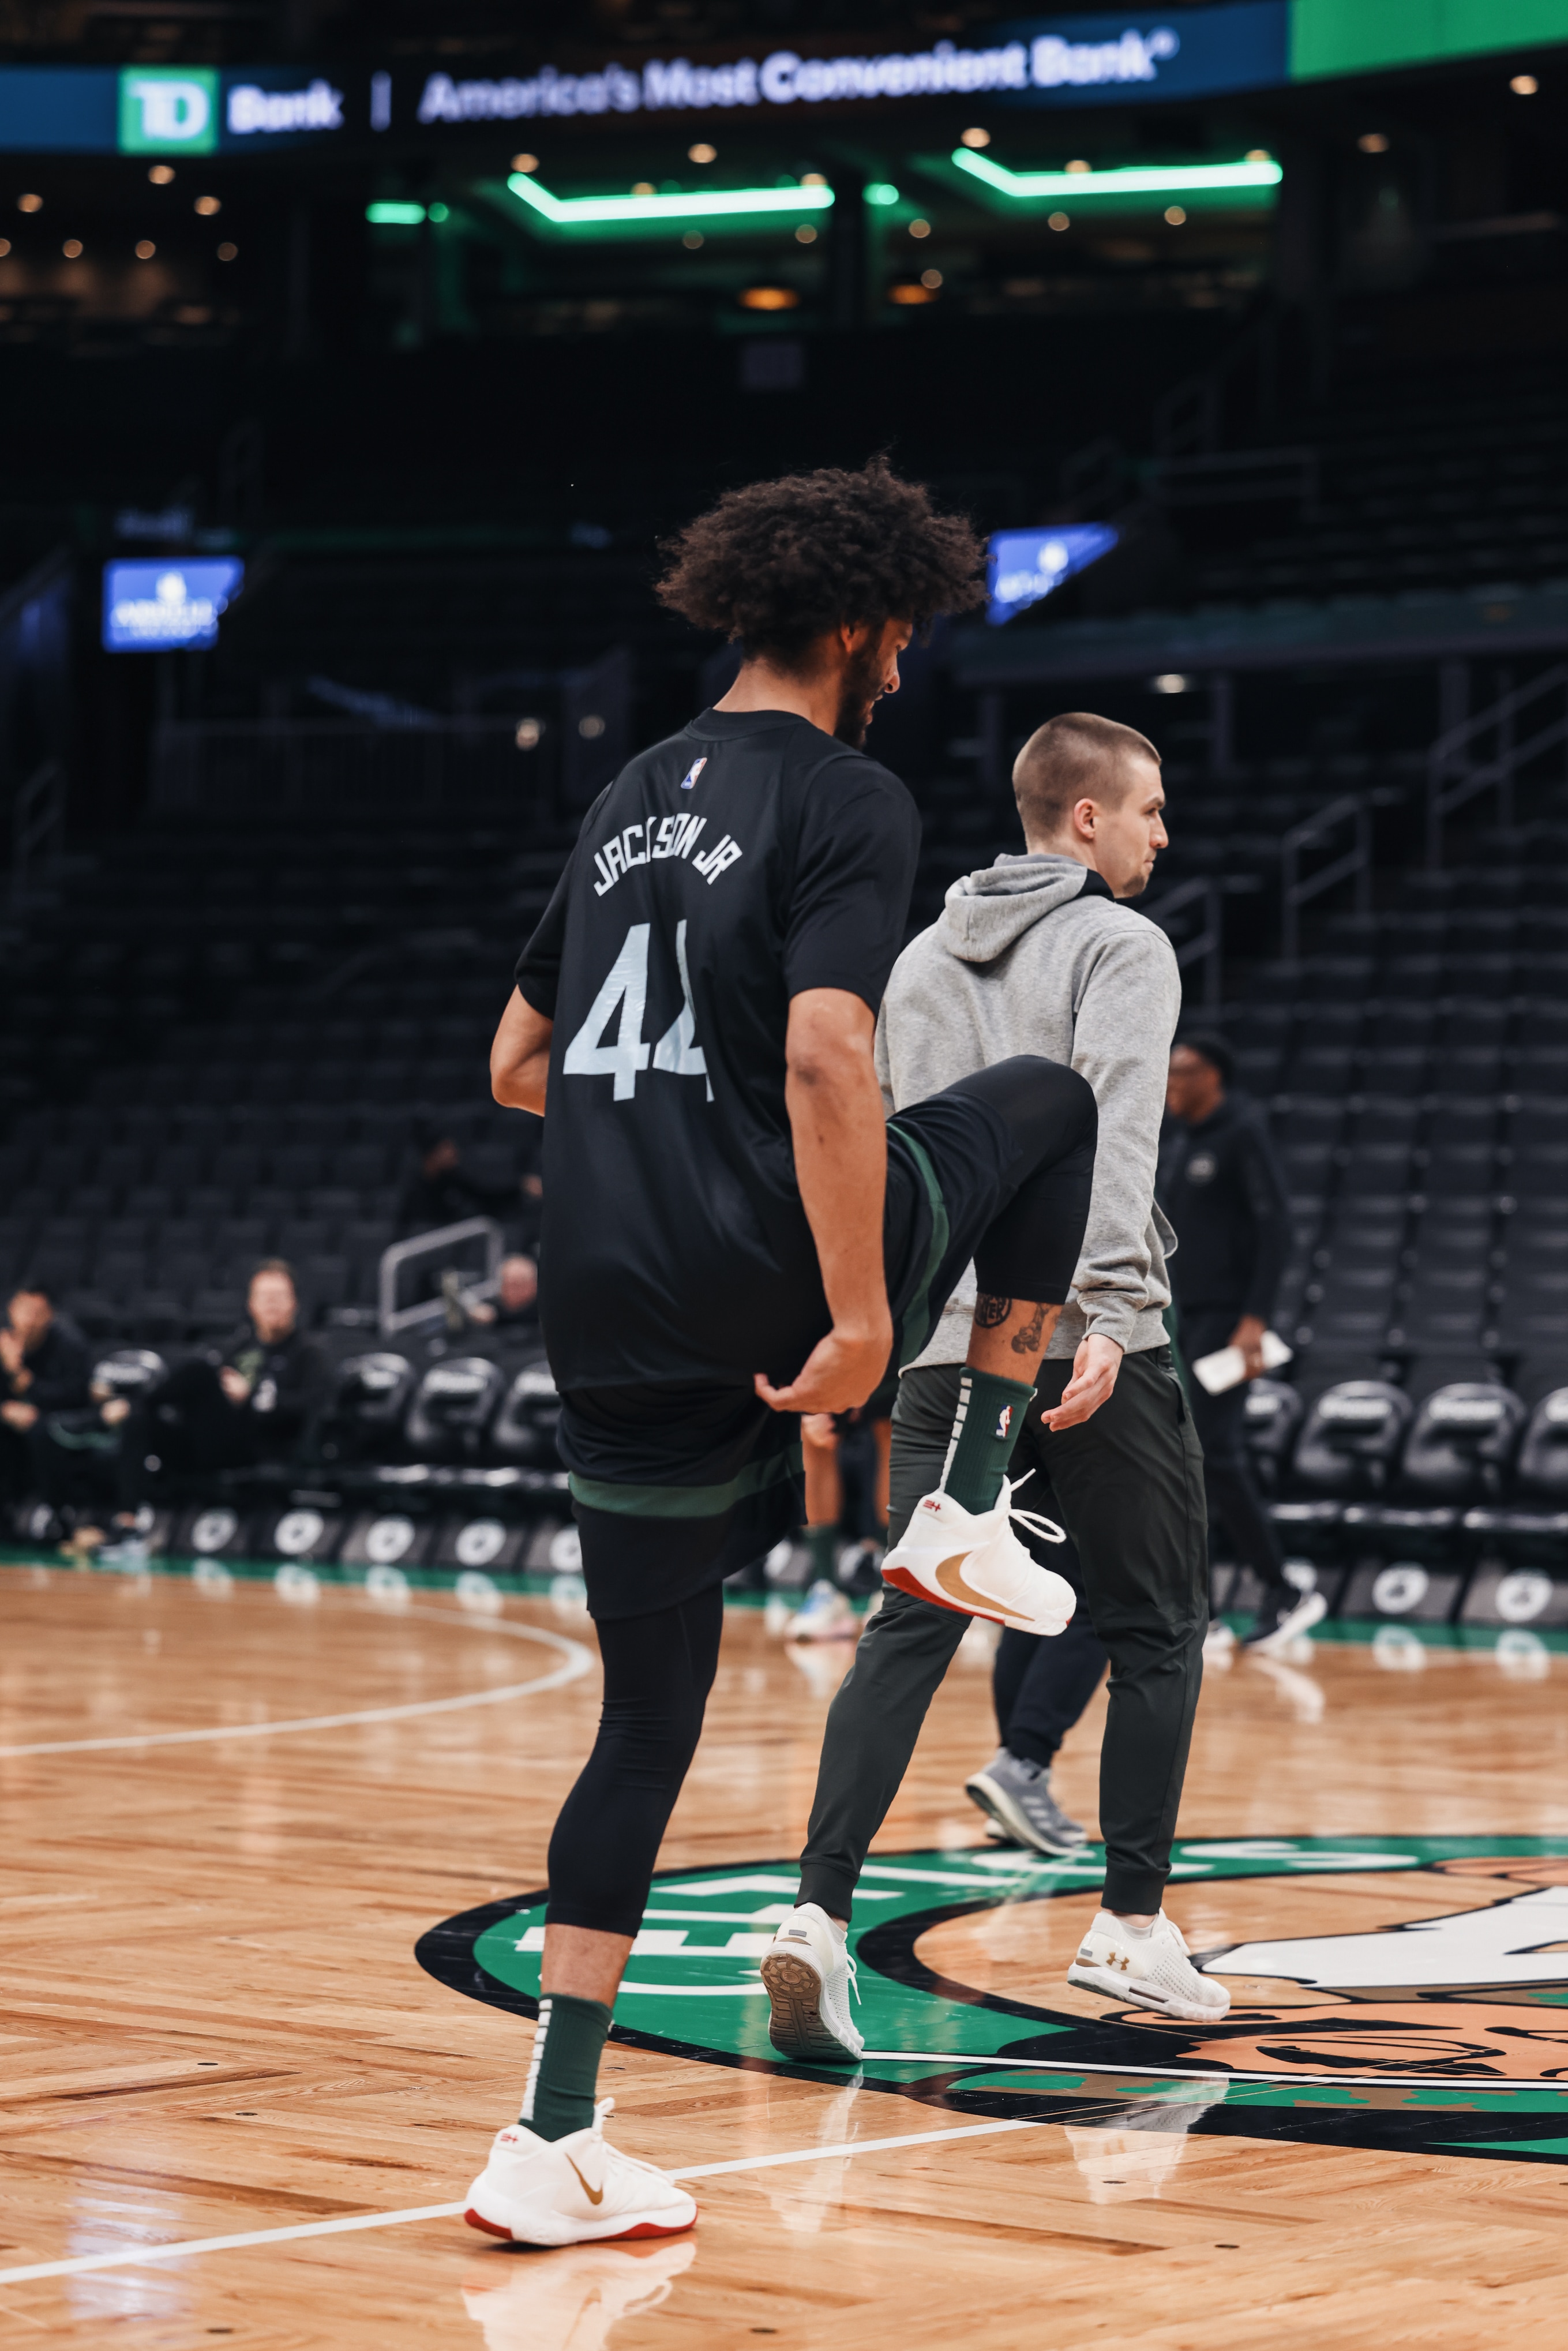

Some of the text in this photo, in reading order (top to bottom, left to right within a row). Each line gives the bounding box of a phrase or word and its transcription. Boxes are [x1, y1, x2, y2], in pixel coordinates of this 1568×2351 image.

[126, 76, 342, 140] TD Bank
[418, 62, 639, 123] America's
[643, 57, 760, 111] Most
[760, 40, 1028, 104] Convenient
[692, 834, 743, 885] JR
